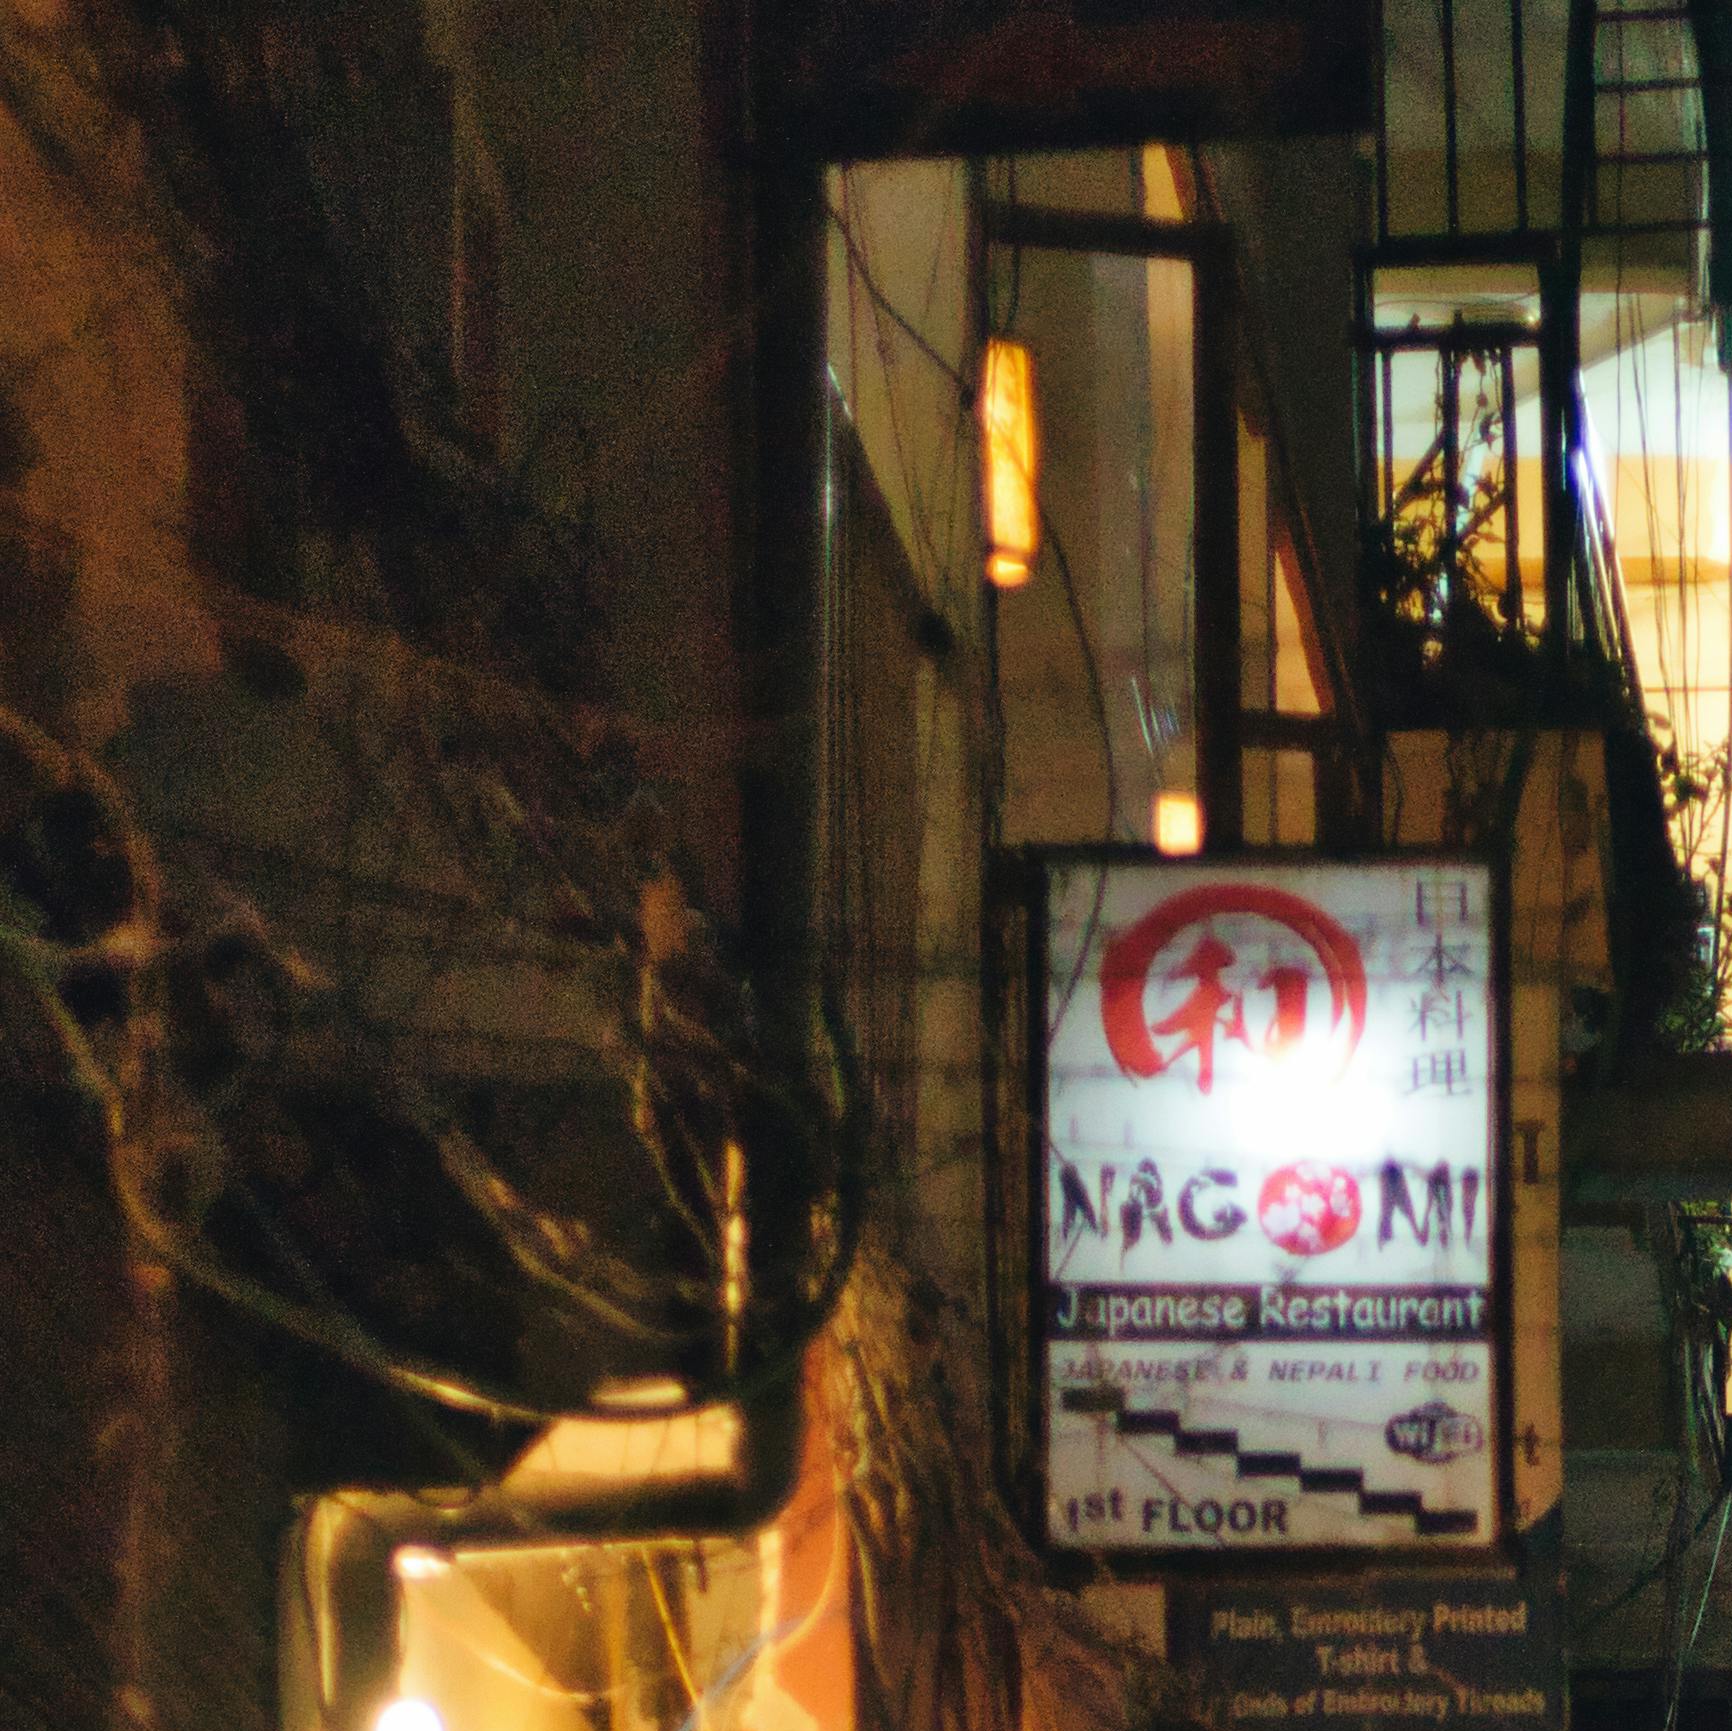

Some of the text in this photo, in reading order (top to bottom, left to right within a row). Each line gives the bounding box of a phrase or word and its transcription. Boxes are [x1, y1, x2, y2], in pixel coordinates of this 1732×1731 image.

[1407, 879, 1472, 1098] 日本料理
[1259, 1286, 1484, 1331] Restaurant
[1061, 1358, 1481, 1383] JAPANESE & NEPALI FOOD
[1068, 1492, 1289, 1537] 1st FLOOR
[1432, 1601, 1528, 1635] Printed
